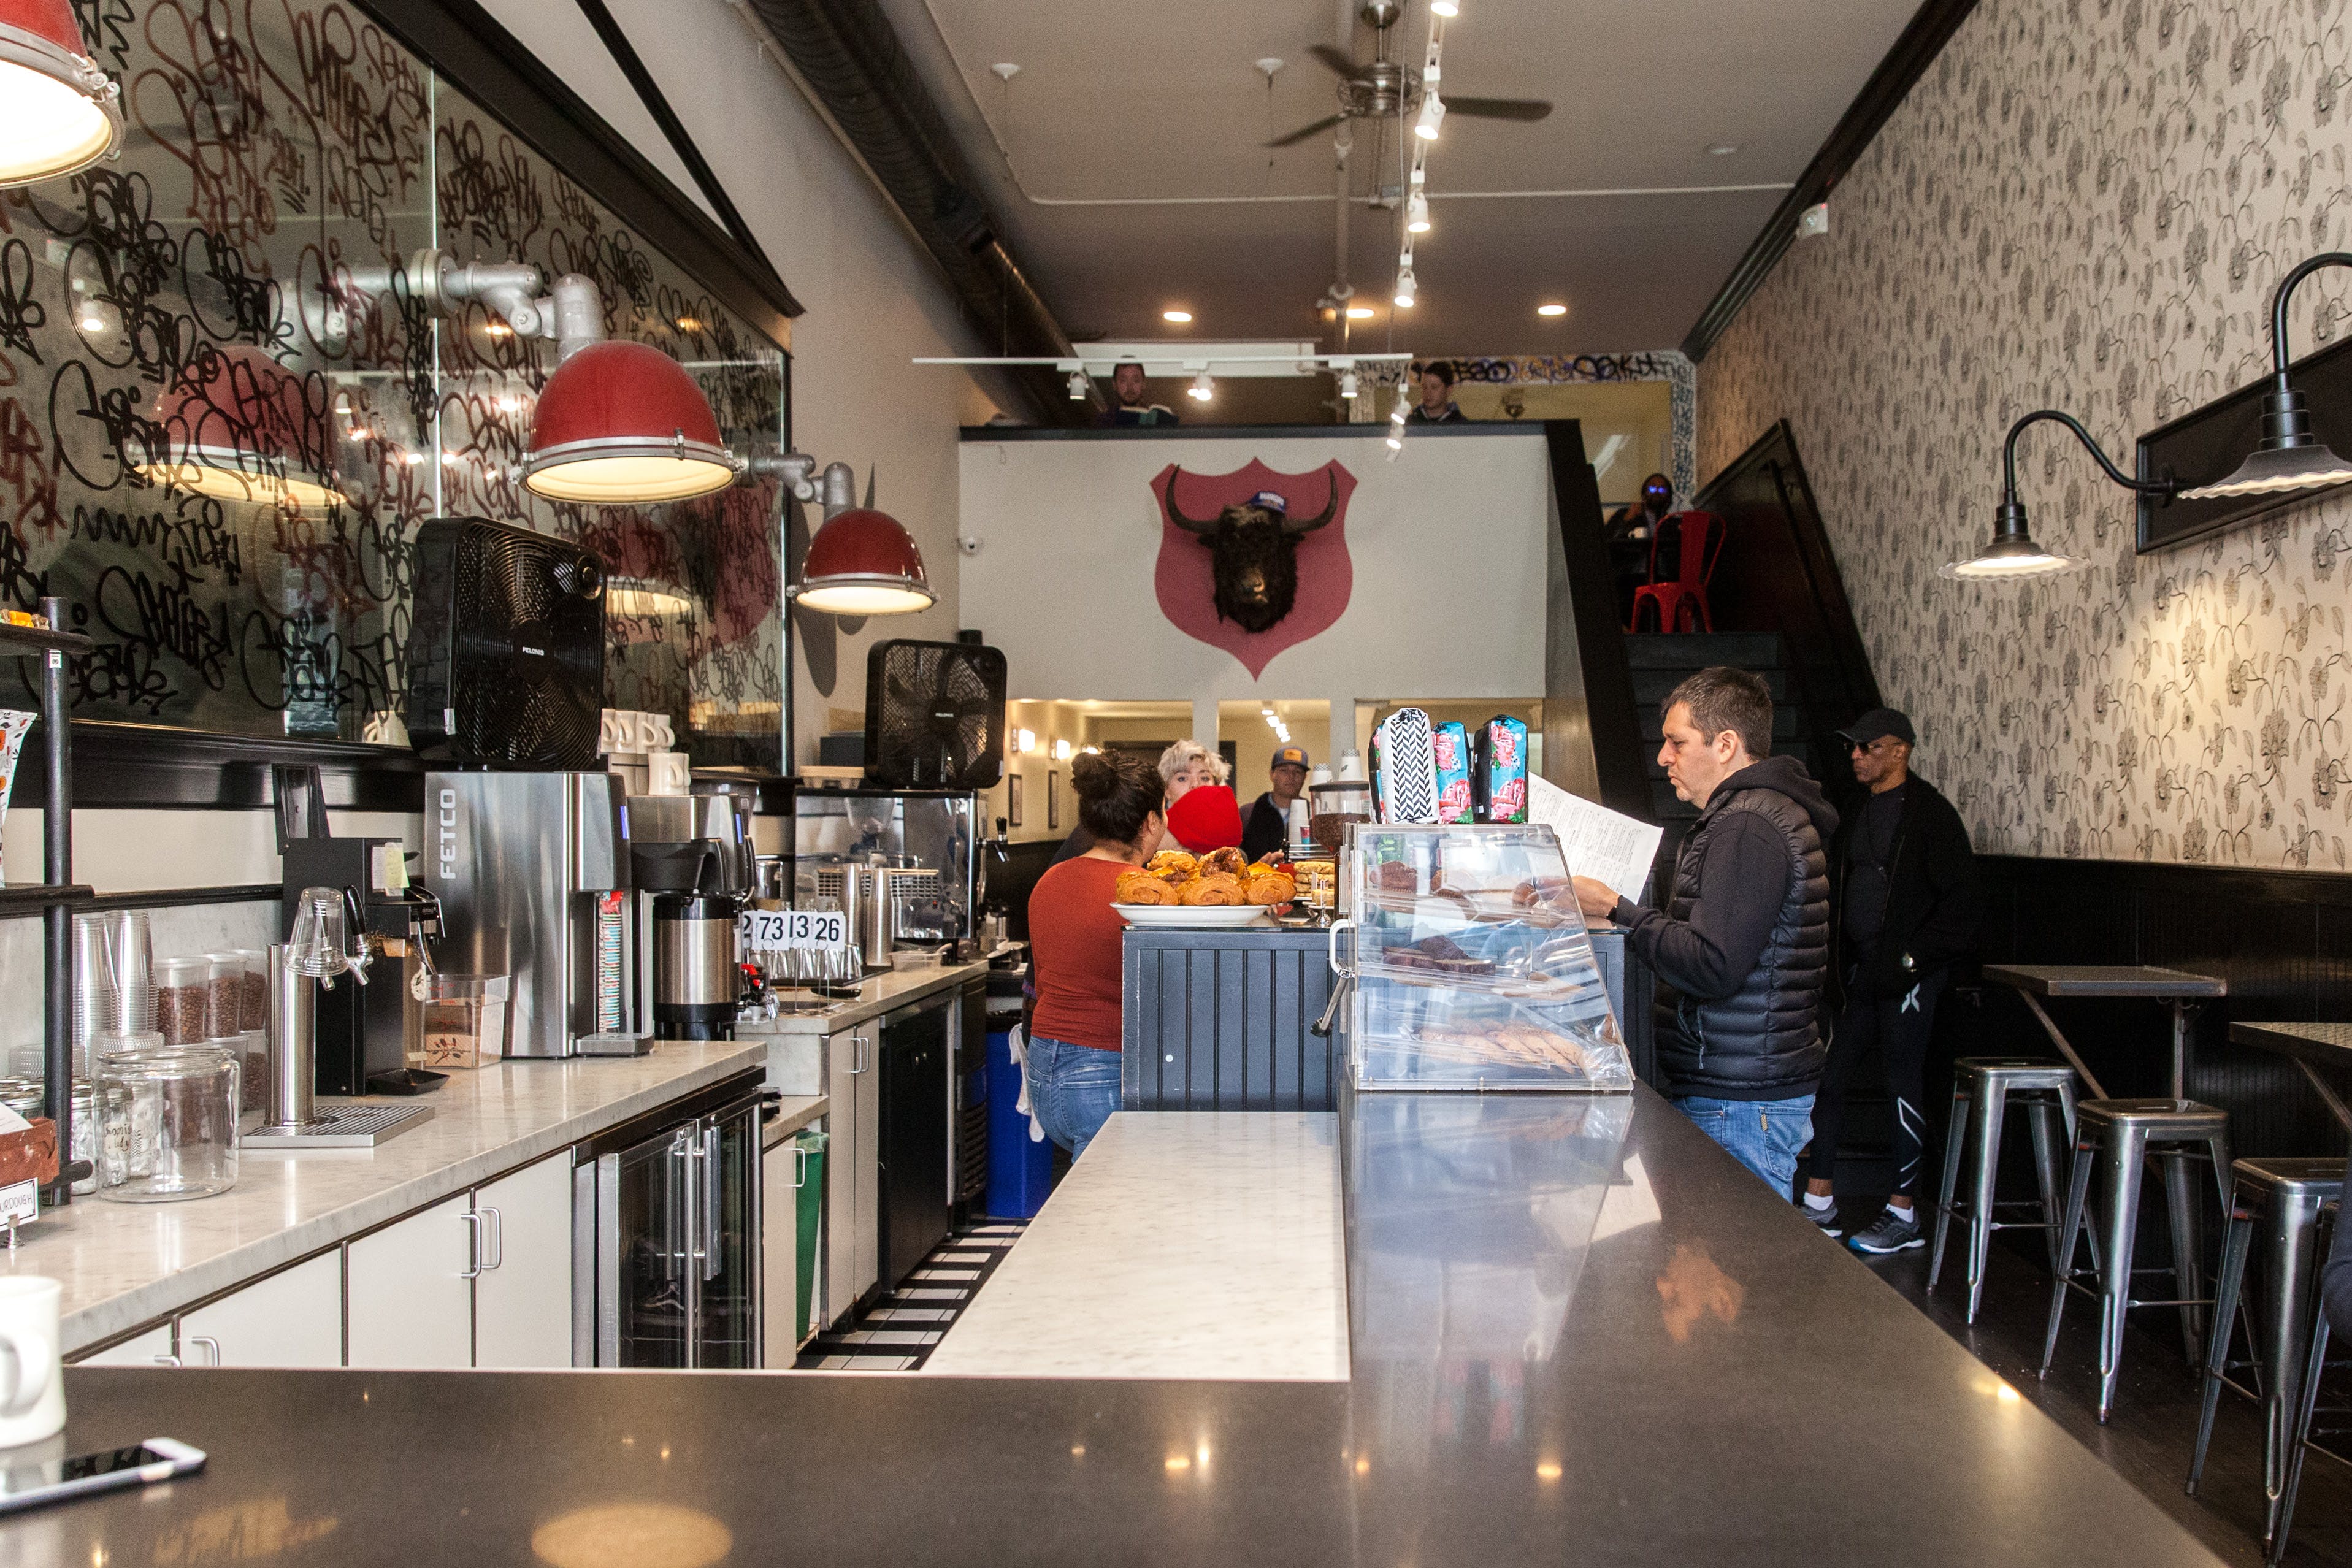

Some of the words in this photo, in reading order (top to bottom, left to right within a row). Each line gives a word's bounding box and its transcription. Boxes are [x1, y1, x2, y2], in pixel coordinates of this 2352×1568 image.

[522, 646, 545, 656] PELONIS
[440, 789, 456, 879] FETCO
[759, 916, 784, 941] 73
[789, 914, 809, 938] 13
[814, 917, 840, 942] 26
